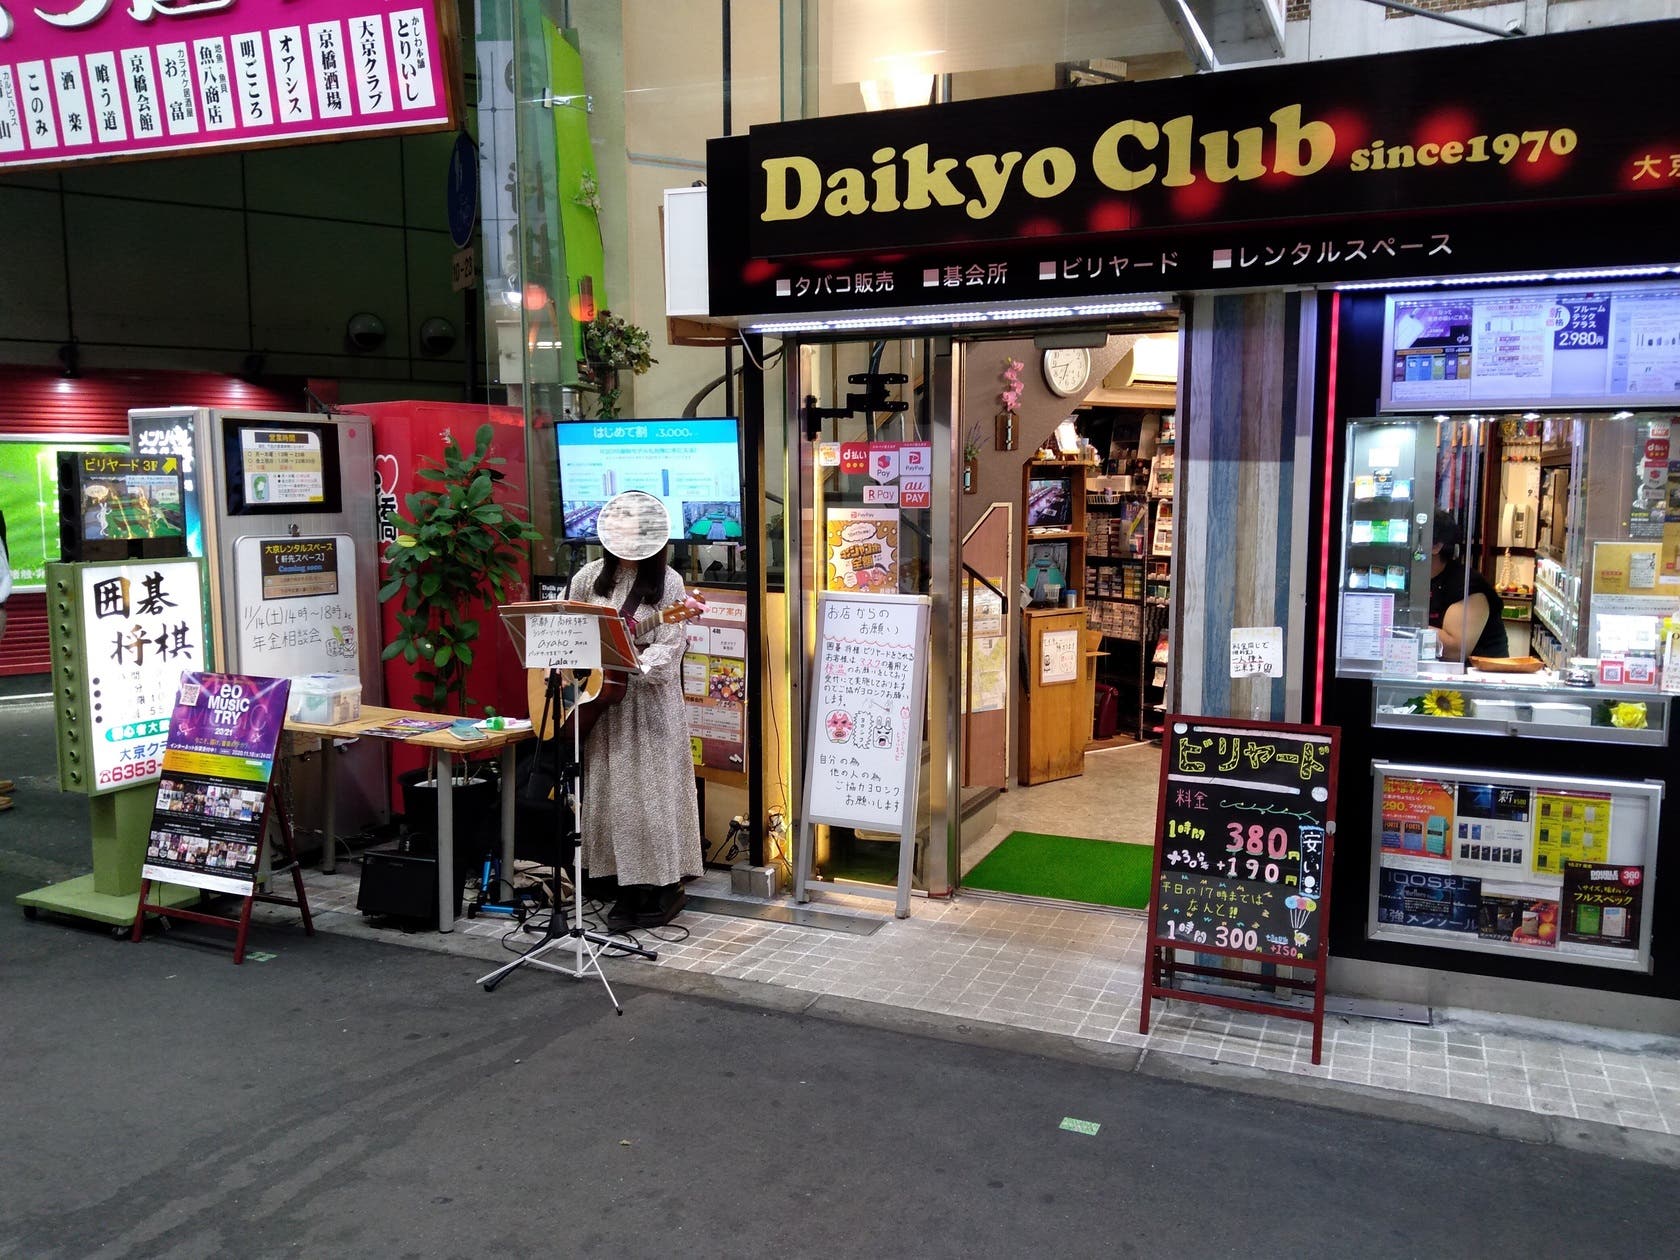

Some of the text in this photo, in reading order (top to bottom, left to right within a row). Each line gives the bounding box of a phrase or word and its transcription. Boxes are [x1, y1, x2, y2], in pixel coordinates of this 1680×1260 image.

[358, 20, 383, 109] 大京クラブ
[397, 18, 419, 102] とりいし
[279, 35, 302, 114] オアシス
[319, 29, 342, 111] 京橋酒場
[130, 54, 154, 132] 京橋会館
[199, 46, 223, 124] 魚八商店
[28, 74, 48, 137] このみ
[761, 103, 1578, 221] Daikyo Club since1970
[1239, 234, 1452, 268] レンタルスペース
[1063, 251, 1179, 280] ビリヤード
[943, 262, 1009, 288] 碁会所
[796, 270, 894, 297] タバコ販売
[1572, 313, 1595, 321] テック
[1574, 305, 1606, 313] プルーム
[1572, 321, 1596, 329] プラス
[594, 426, 648, 438] はじめて割
[843, 449, 867, 460] d払い
[85, 458, 140, 473] ビリヤード
[877, 469, 890, 478] Pay
[877, 490, 894, 499] Pay
[905, 482, 924, 491] au
[906, 494, 925, 503] PAY
[265, 542, 334, 554] 大京レンタルスペース
[94, 570, 179, 620] 囲碁
[711, 607, 743, 617] ロア案内
[828, 604, 889, 620] お店からの
[859, 623, 899, 636] お願い
[110, 620, 194, 667] 将棋
[221, 684, 242, 698] eo
[208, 695, 250, 712] MUSIC
[214, 710, 241, 725] TRY
[1179, 737, 1329, 779] ビリヤード
[1175, 789, 1208, 810] 料金
[1624, 870, 1640, 880] 360
